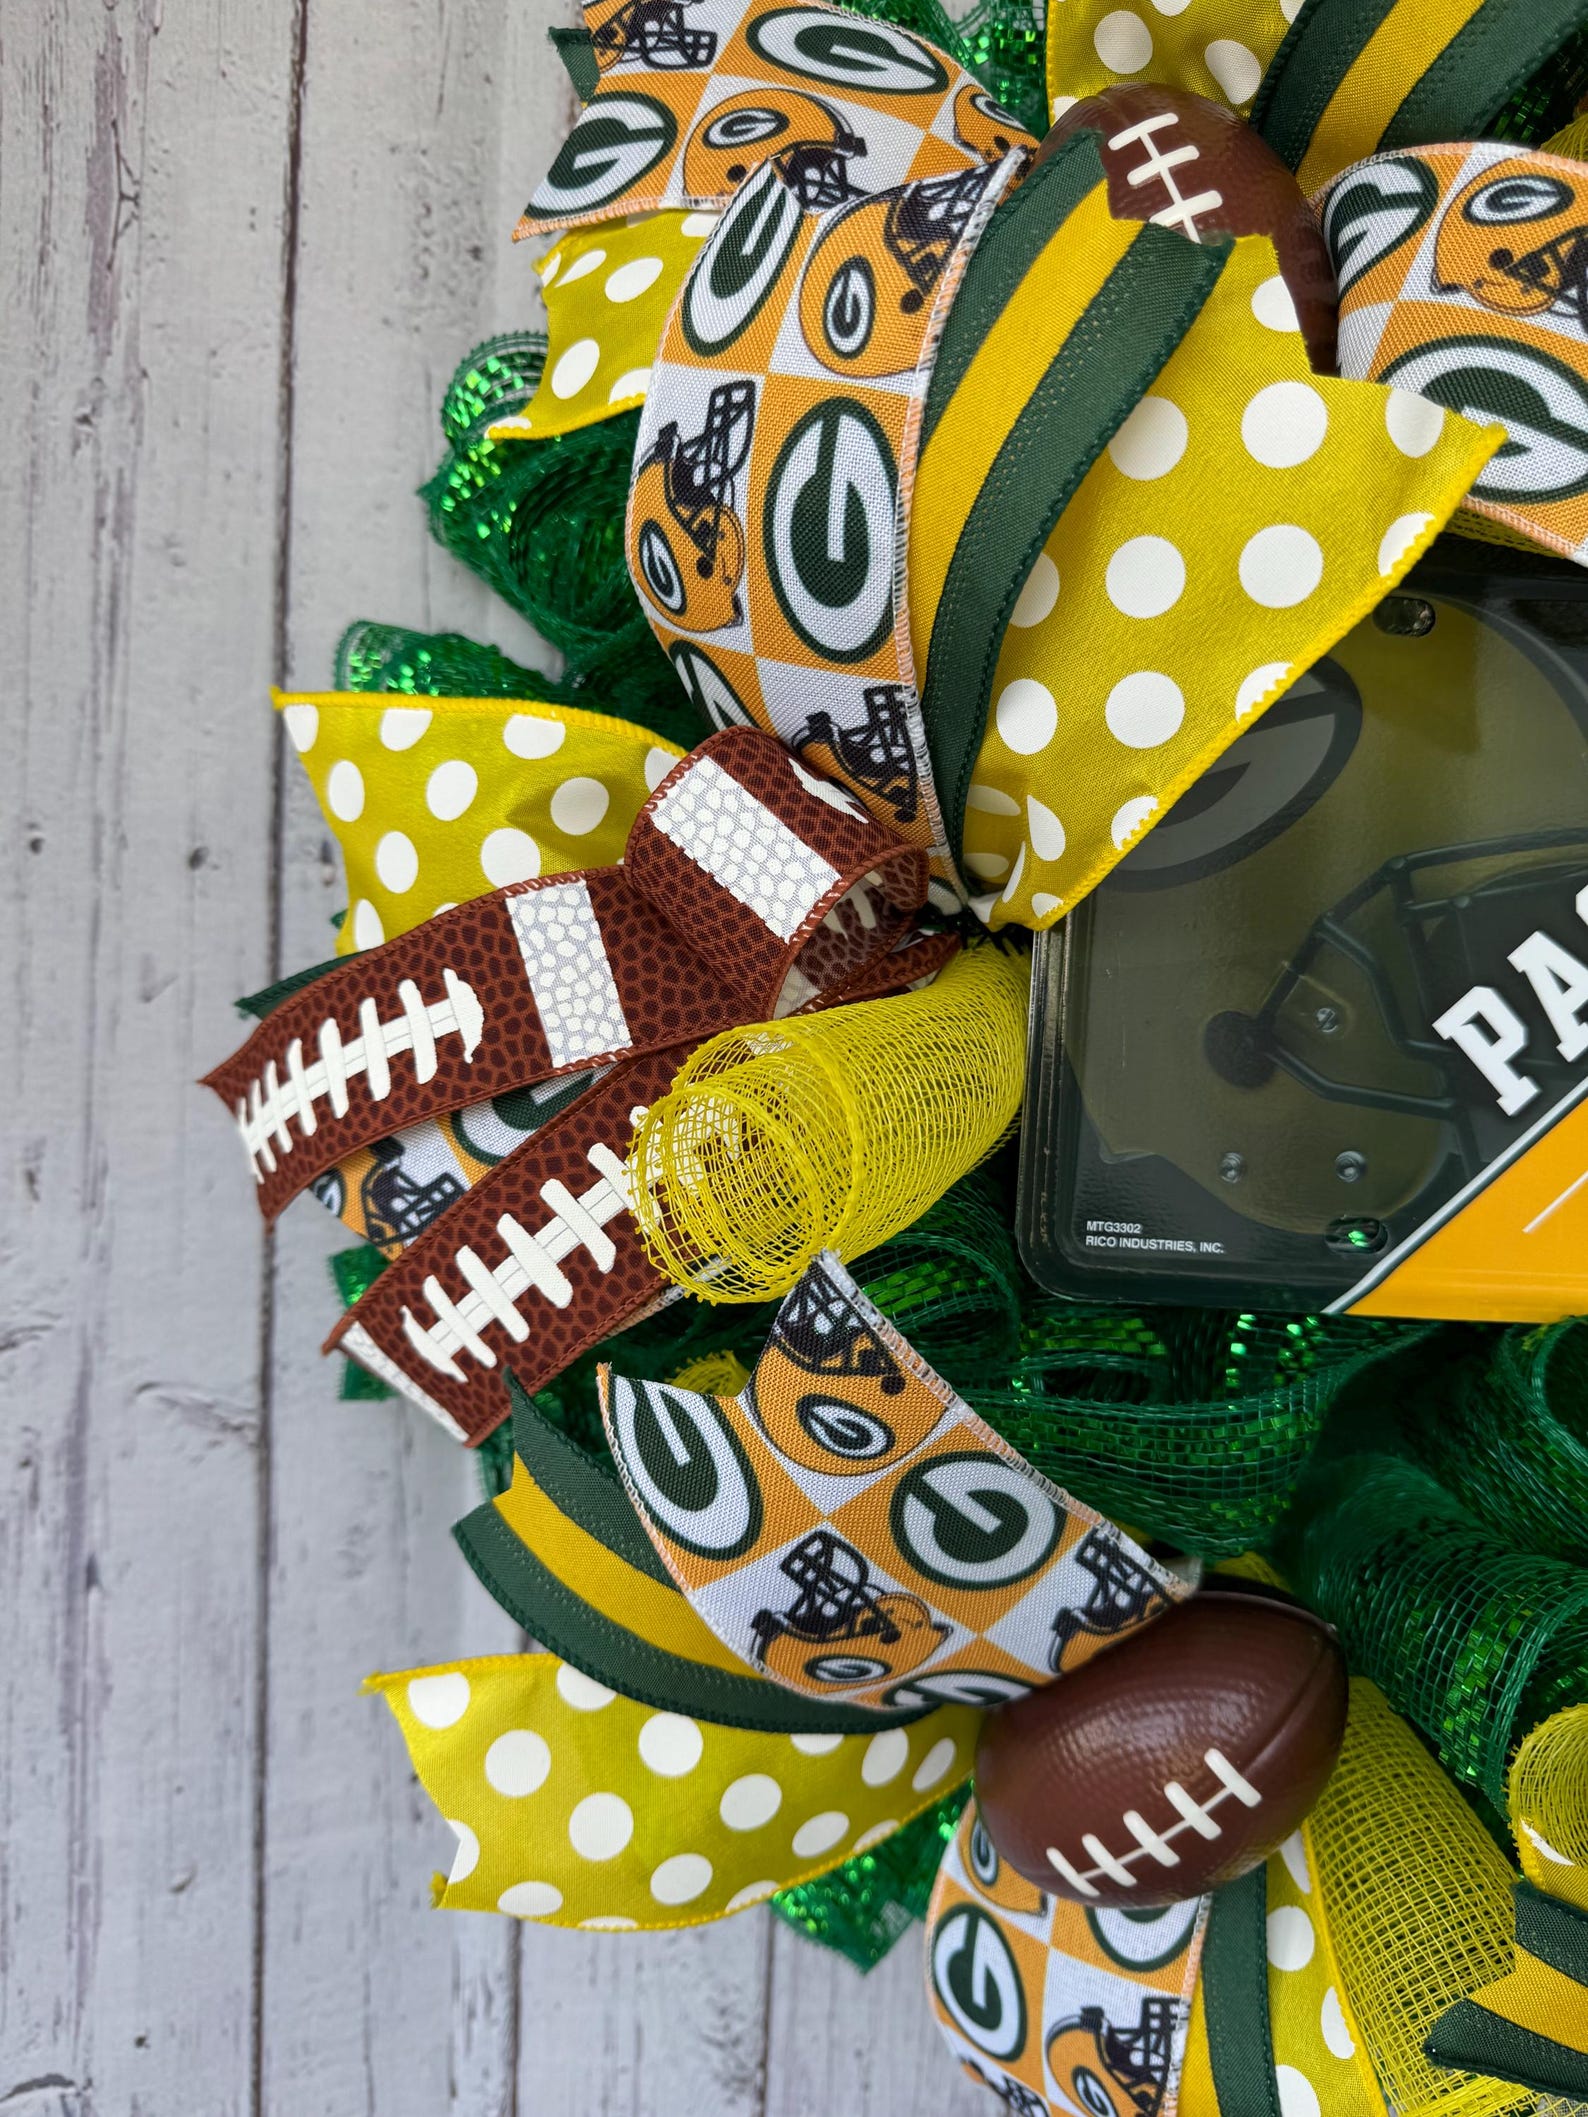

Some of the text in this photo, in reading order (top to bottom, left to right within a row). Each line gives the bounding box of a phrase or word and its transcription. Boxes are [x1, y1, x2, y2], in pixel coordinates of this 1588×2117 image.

[755, 9, 940, 91] G
[706, 109, 783, 148] G
[1467, 176, 1564, 223] G
[826, 263, 872, 356] G
[639, 525, 685, 613] G
[771, 412, 898, 654] G
[1431, 884, 1588, 1117] PA
[1085, 1235, 1225, 1254] RICO INDUSTRIES, INC.
[1086, 1220, 1142, 1234] MTG3302
[611, 1375, 752, 1551] G
[803, 1401, 889, 1456] G
[901, 1458, 1058, 1583] G
[933, 1912, 1023, 2055] G
